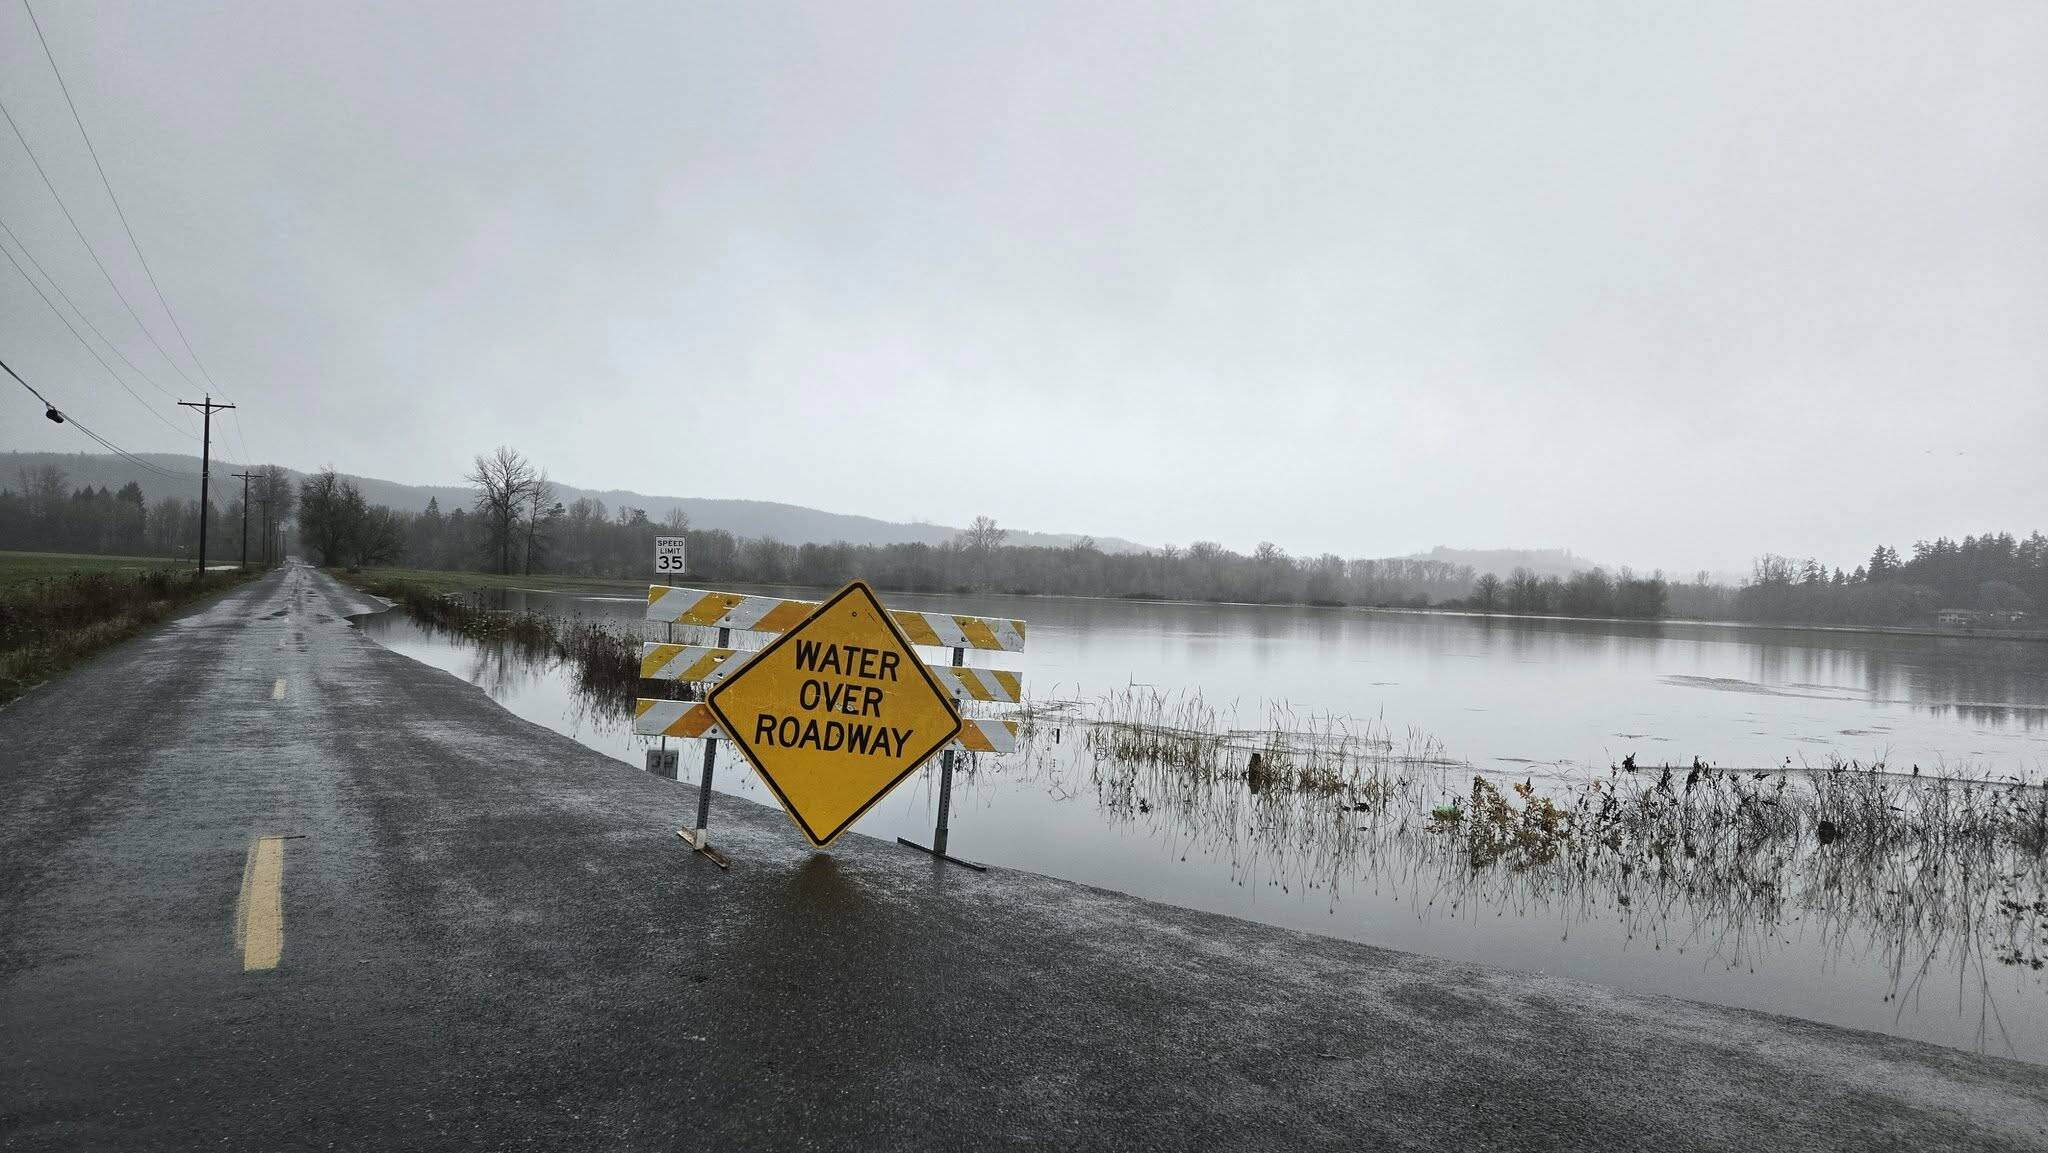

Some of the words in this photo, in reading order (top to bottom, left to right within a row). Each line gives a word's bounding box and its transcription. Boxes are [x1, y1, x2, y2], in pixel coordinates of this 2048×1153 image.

[658, 556, 683, 570] 35
[795, 639, 900, 682] WATER
[799, 679, 883, 718] OVER
[754, 713, 913, 758] ROADWAY
